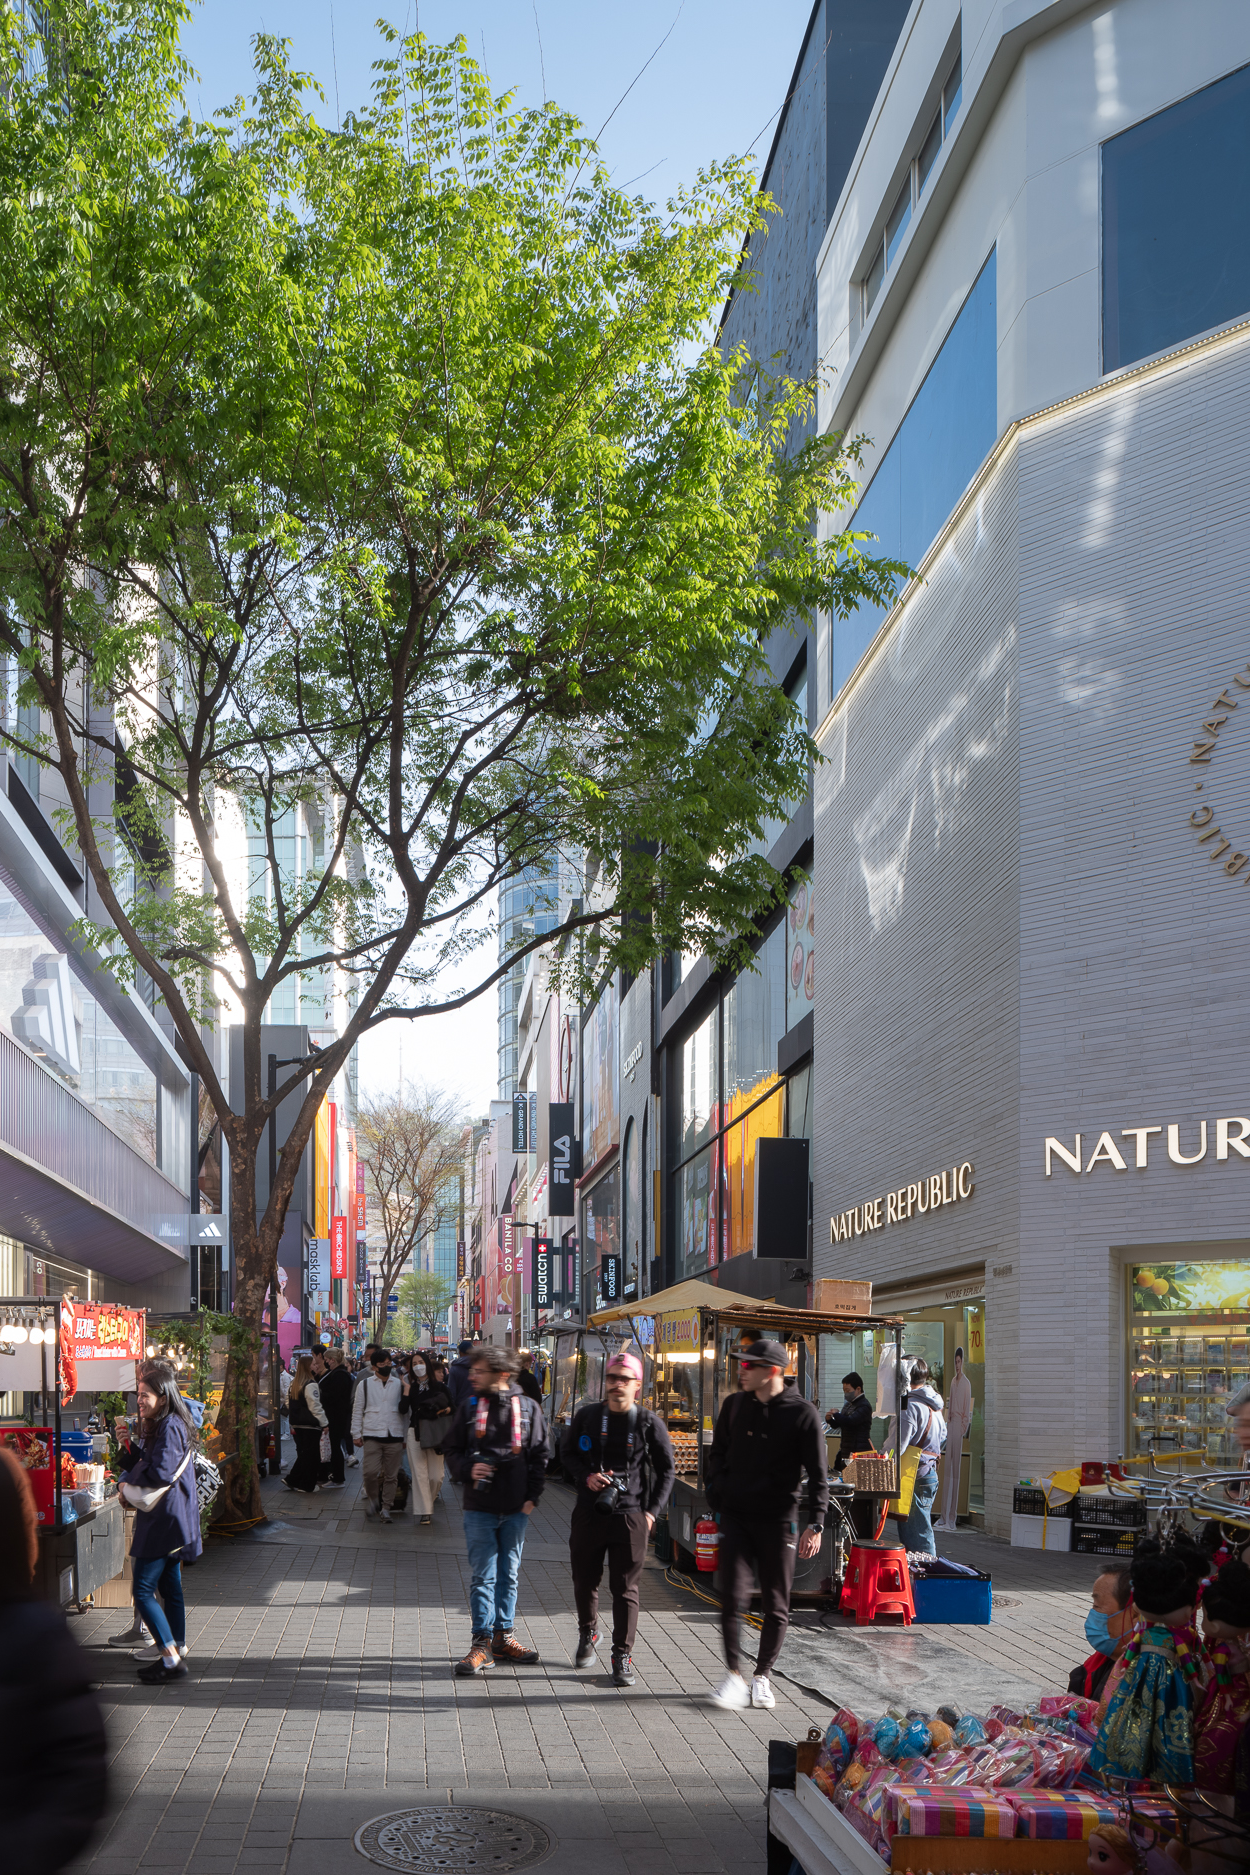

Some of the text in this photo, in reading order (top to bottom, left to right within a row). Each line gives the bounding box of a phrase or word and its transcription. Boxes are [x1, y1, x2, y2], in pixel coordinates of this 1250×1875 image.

[553, 1135, 570, 1184] FILA
[1044, 1117, 1250, 1176] NATUR
[830, 1161, 974, 1244] NATURE REPUBLIC
[309, 1239, 320, 1291] masklab
[504, 1217, 512, 1272] BANILA CO
[538, 1253, 548, 1304] swatch
[608, 1258, 616, 1297] SKINFOOD
[945, 1289, 962, 1300] NATURE
